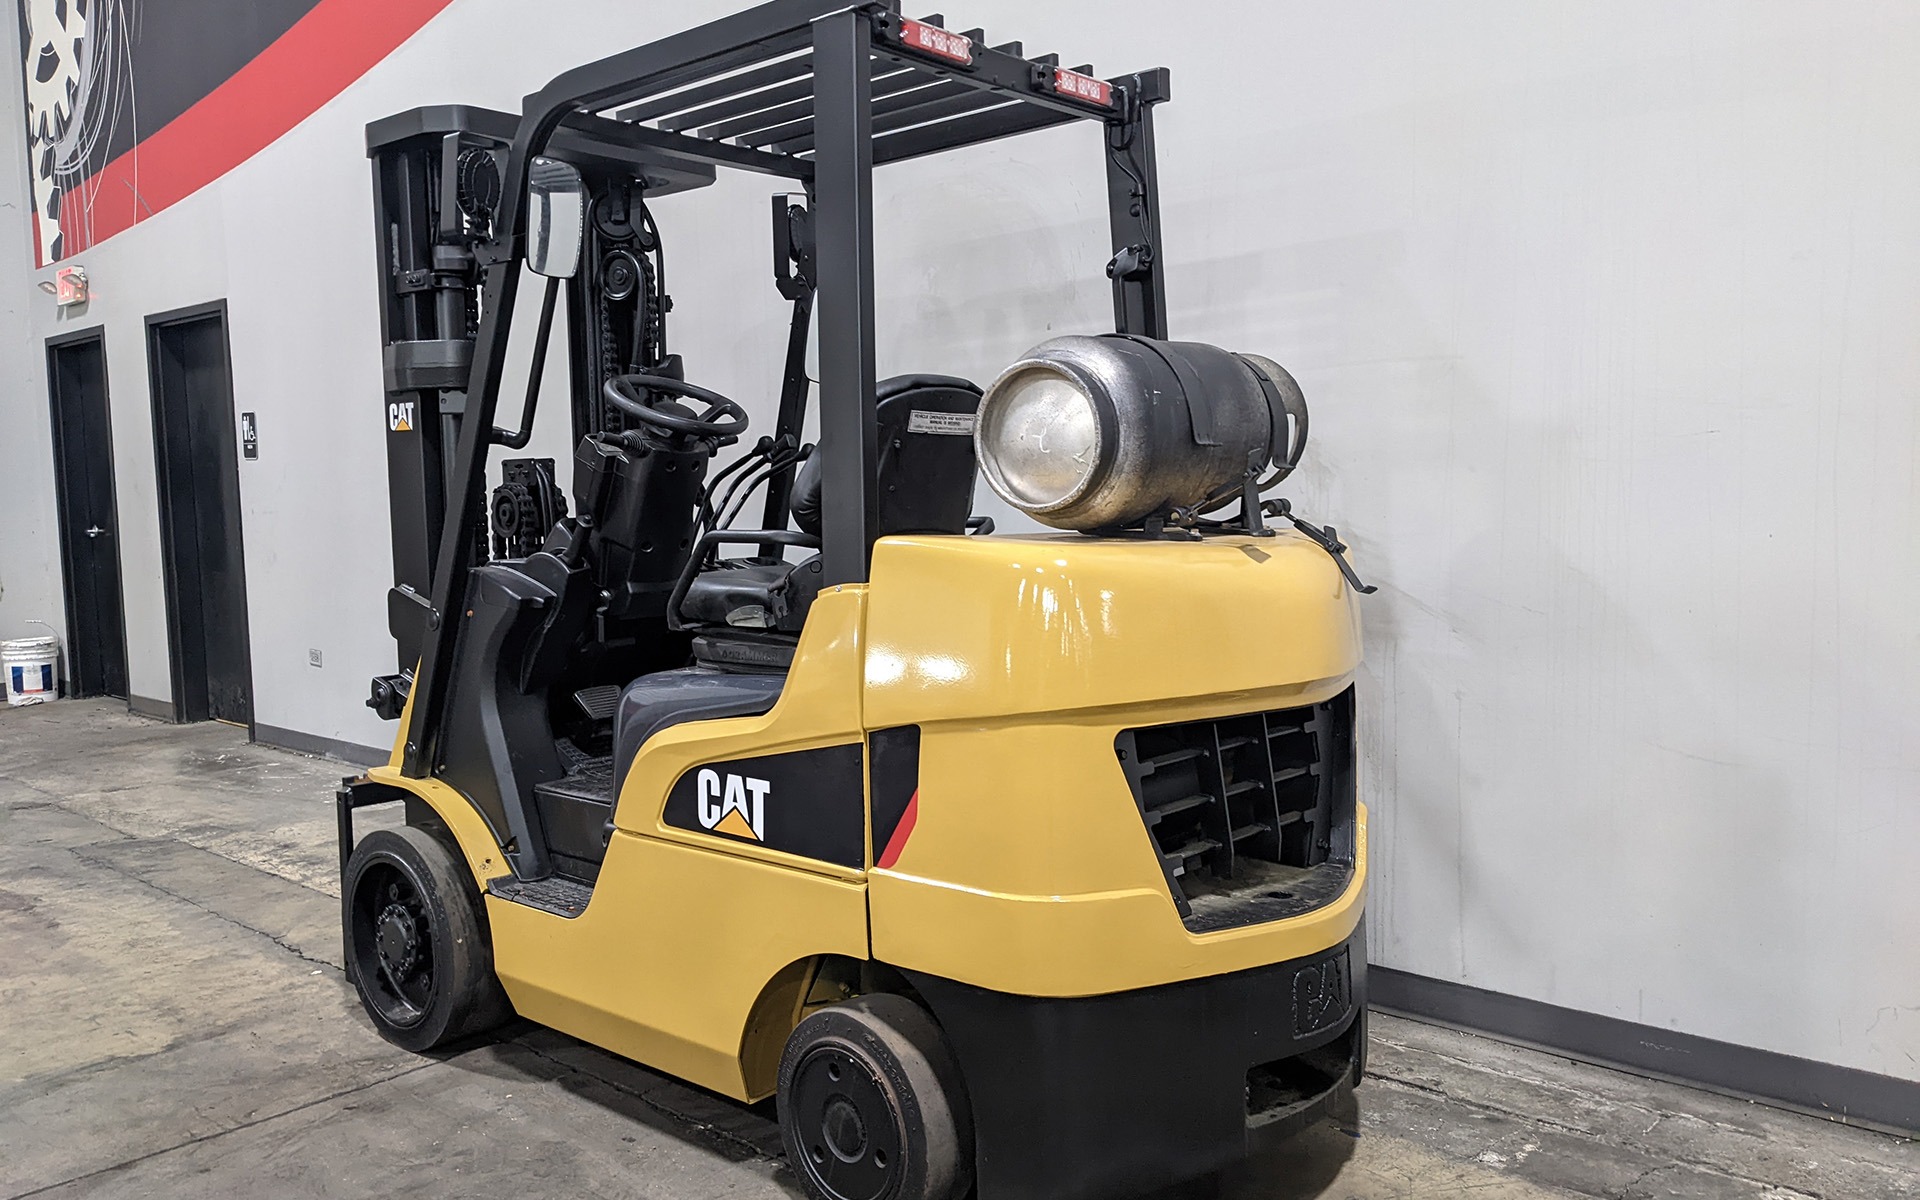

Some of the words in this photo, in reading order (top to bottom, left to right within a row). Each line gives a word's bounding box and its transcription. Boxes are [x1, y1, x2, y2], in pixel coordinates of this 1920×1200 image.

[389, 402, 414, 431] CAT
[698, 768, 771, 842] CAT
[1293, 952, 1350, 1035] CAT
